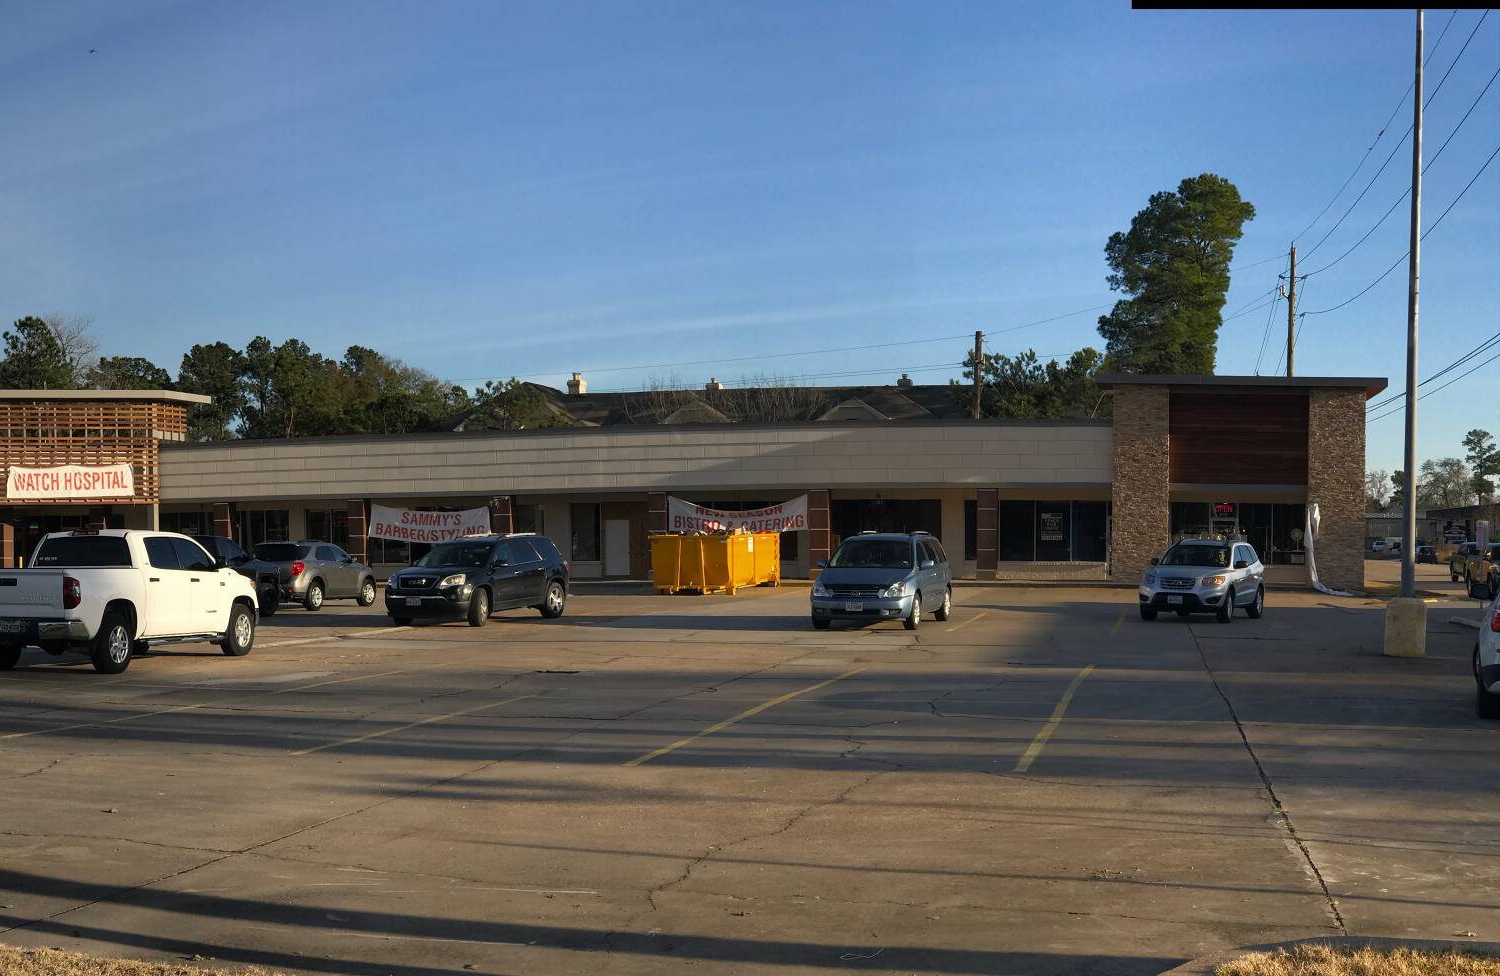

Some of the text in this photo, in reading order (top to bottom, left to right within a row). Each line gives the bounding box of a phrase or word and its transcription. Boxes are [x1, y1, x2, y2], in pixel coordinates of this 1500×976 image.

[14, 470, 128, 491] WATCH HOSPITAL
[1213, 504, 1233, 513] OPEN
[401, 511, 462, 526] SAMMY'S
[740, 514, 804, 532] CATERING
